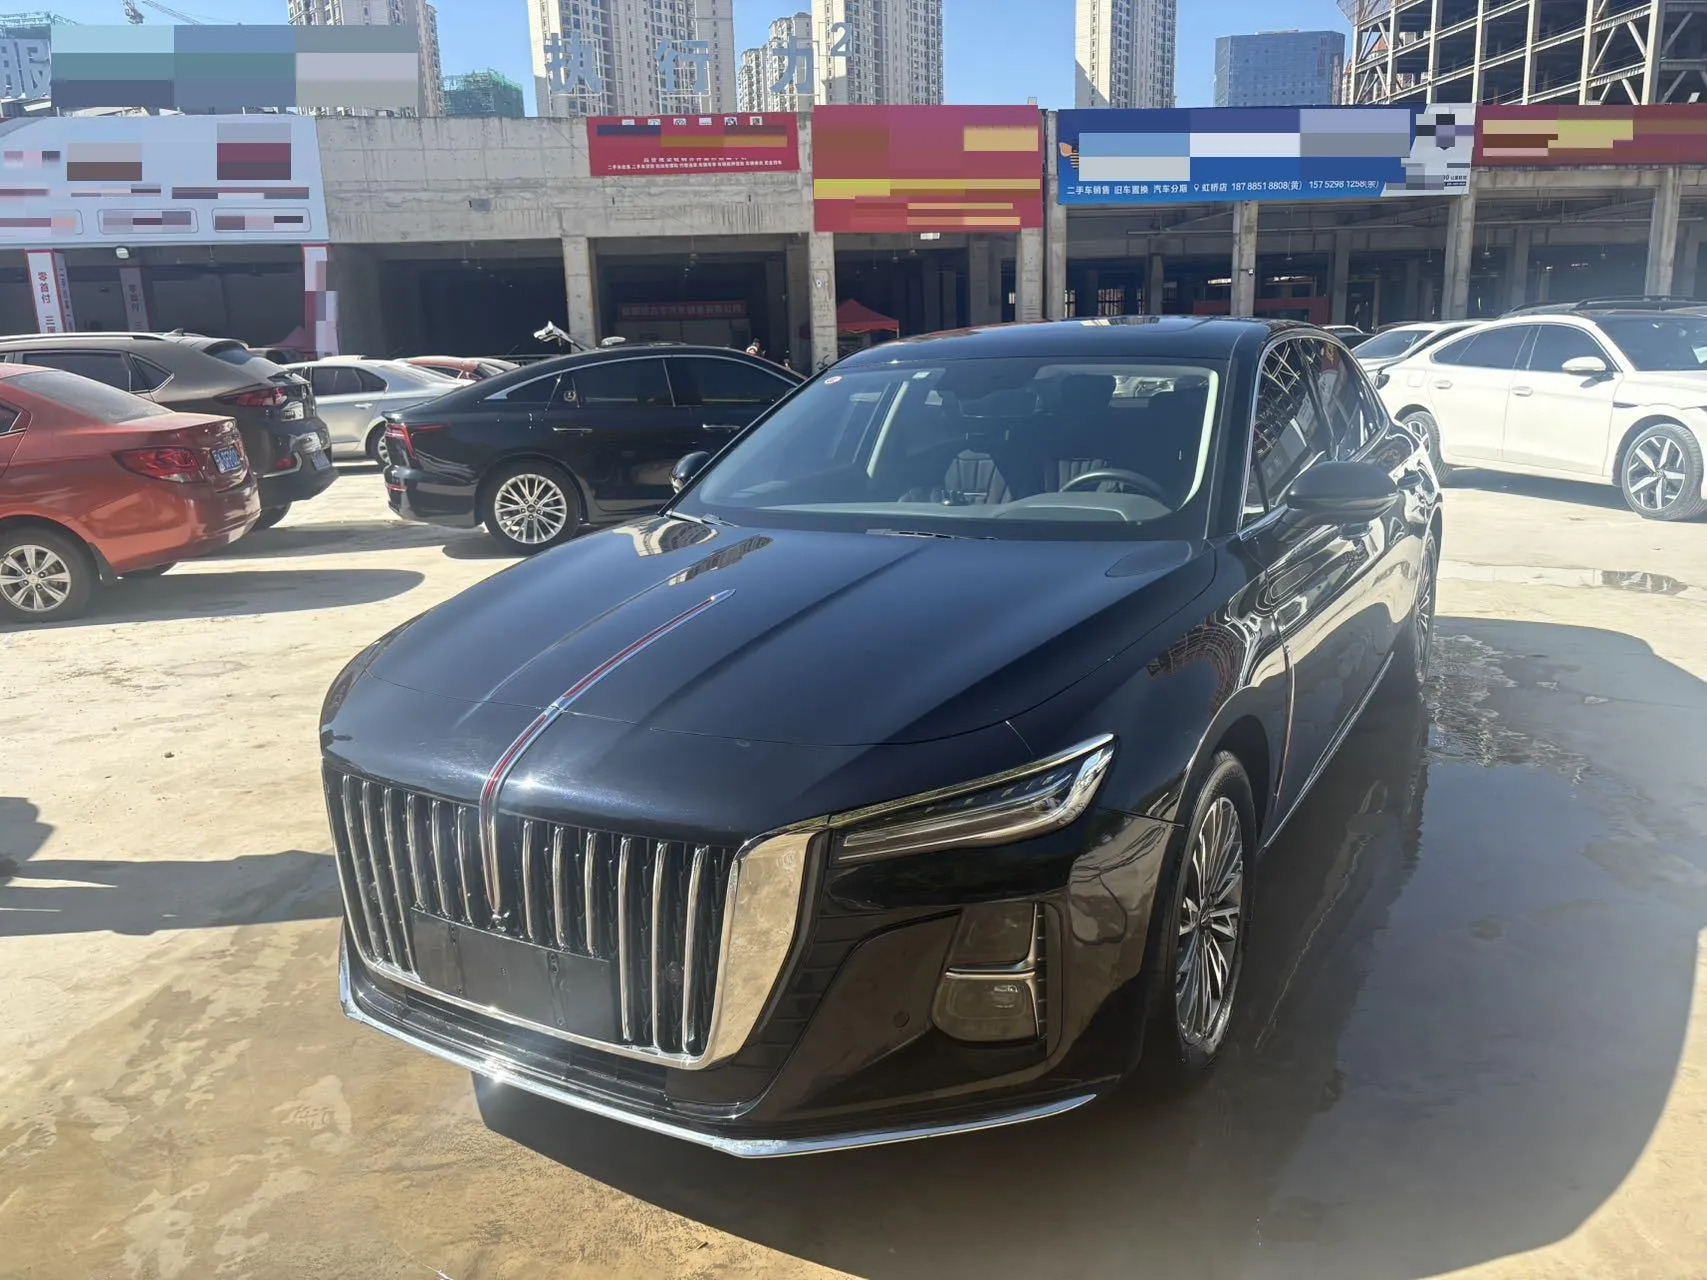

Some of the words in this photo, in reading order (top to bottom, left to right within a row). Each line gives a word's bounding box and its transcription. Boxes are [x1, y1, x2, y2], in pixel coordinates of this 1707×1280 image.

[1067, 185, 1110, 195] 二手车销售
[1114, 185, 1149, 195] 旧车置换
[1153, 184, 1188, 194] 汽车分期
[1202, 182, 1228, 192] 虹桥店
[37, 271, 51, 304] 零首付
